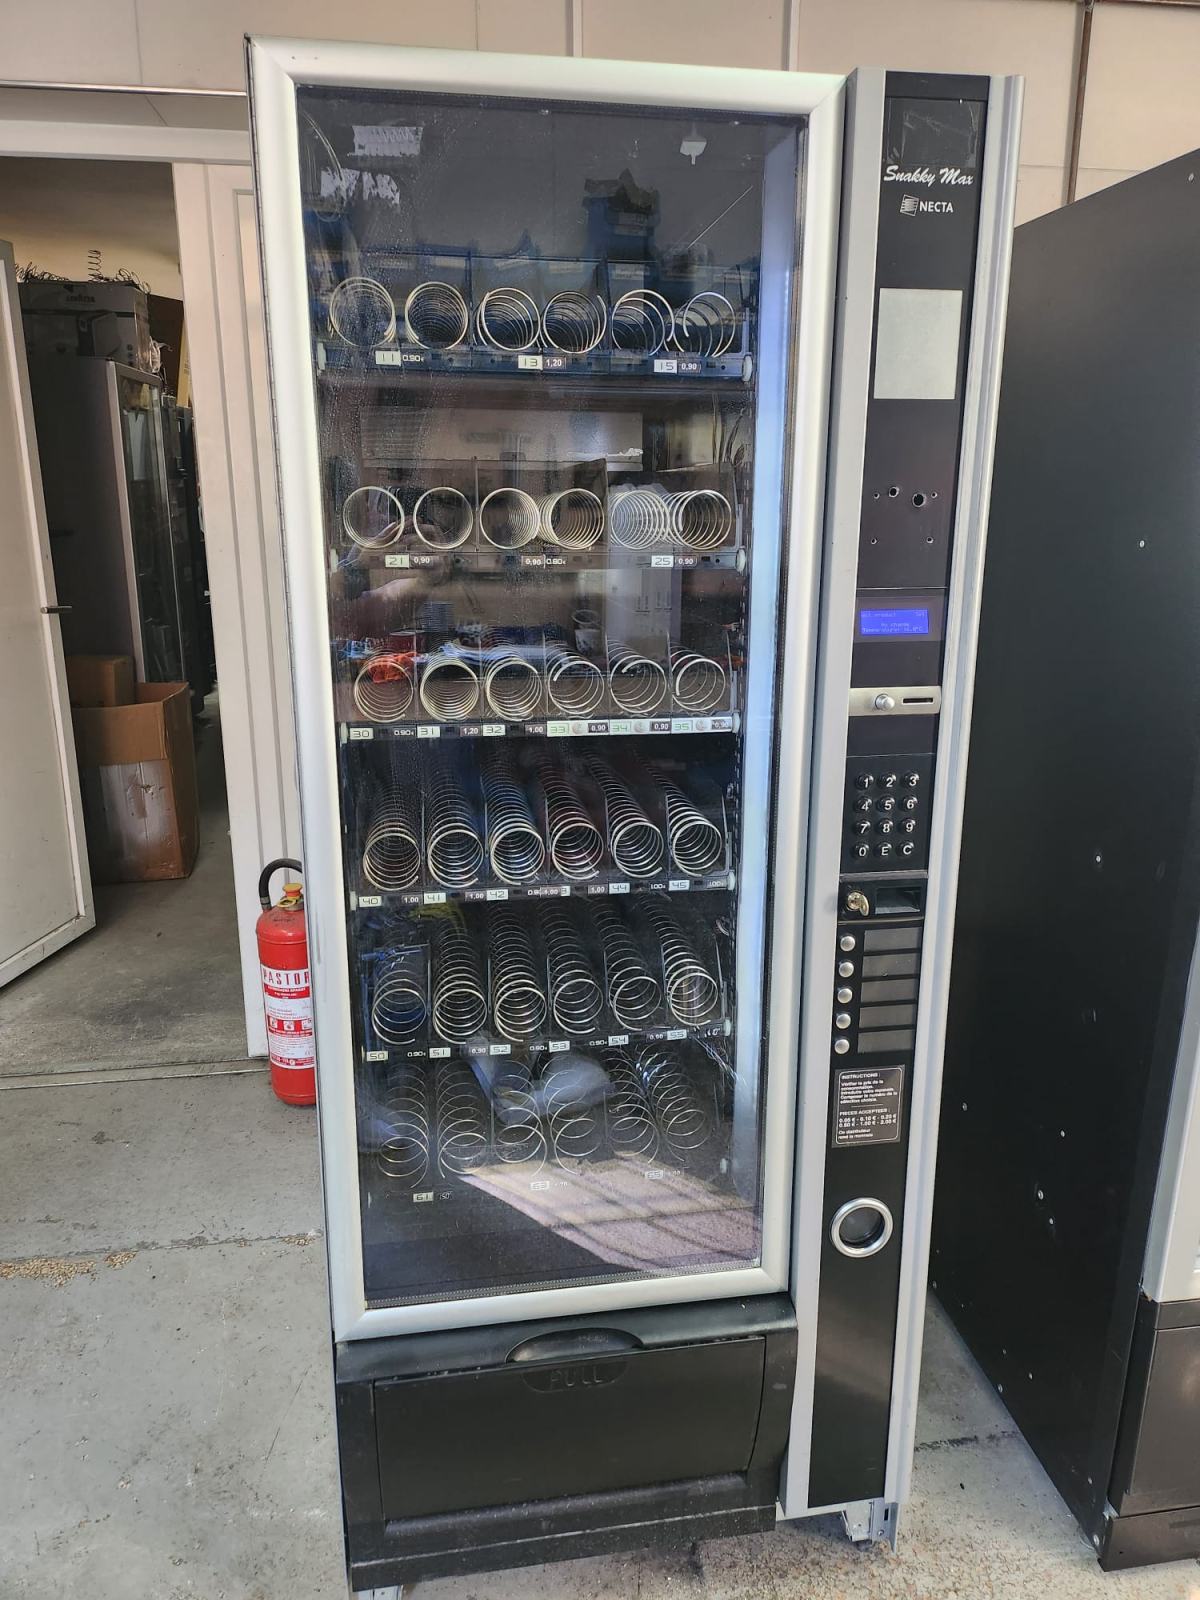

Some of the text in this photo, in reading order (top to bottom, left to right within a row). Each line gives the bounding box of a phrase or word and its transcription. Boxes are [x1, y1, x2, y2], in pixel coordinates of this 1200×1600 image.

[884, 164, 974, 187] Snakky Max
[919, 201, 954, 213] NECTA
[524, 358, 538, 367] 13
[660, 362, 674, 371] 15
[389, 556, 403, 565] 21
[655, 557, 671, 566] 25
[352, 730, 370, 738] 30
[420, 727, 434, 736] 31
[486, 726, 502, 734] 32
[550, 726, 566, 734] 33
[864, 777, 869, 788] 1
[886, 777, 893, 788] 2
[909, 776, 917, 786] 3
[861, 801, 869, 811] 4
[884, 800, 892, 810] 5
[906, 799, 914, 809] 6
[860, 823, 868, 834] 7
[882, 823, 890, 833] 8
[906, 822, 914, 832] 9
[859, 847, 867, 857] 0
[881, 846, 889, 856] E
[903, 845, 912, 855] C
[612, 884, 627, 892] 44
[672, 881, 687, 889] 45
[427, 894, 440, 902] 41
[490, 891, 505, 899] 42
[362, 897, 378, 905] 40
[611, 1036, 626, 1044] 54
[493, 1045, 508, 1053] 52
[552, 1042, 567, 1050] 53
[369, 1052, 385, 1060] 50
[432, 1049, 445, 1057] 51
